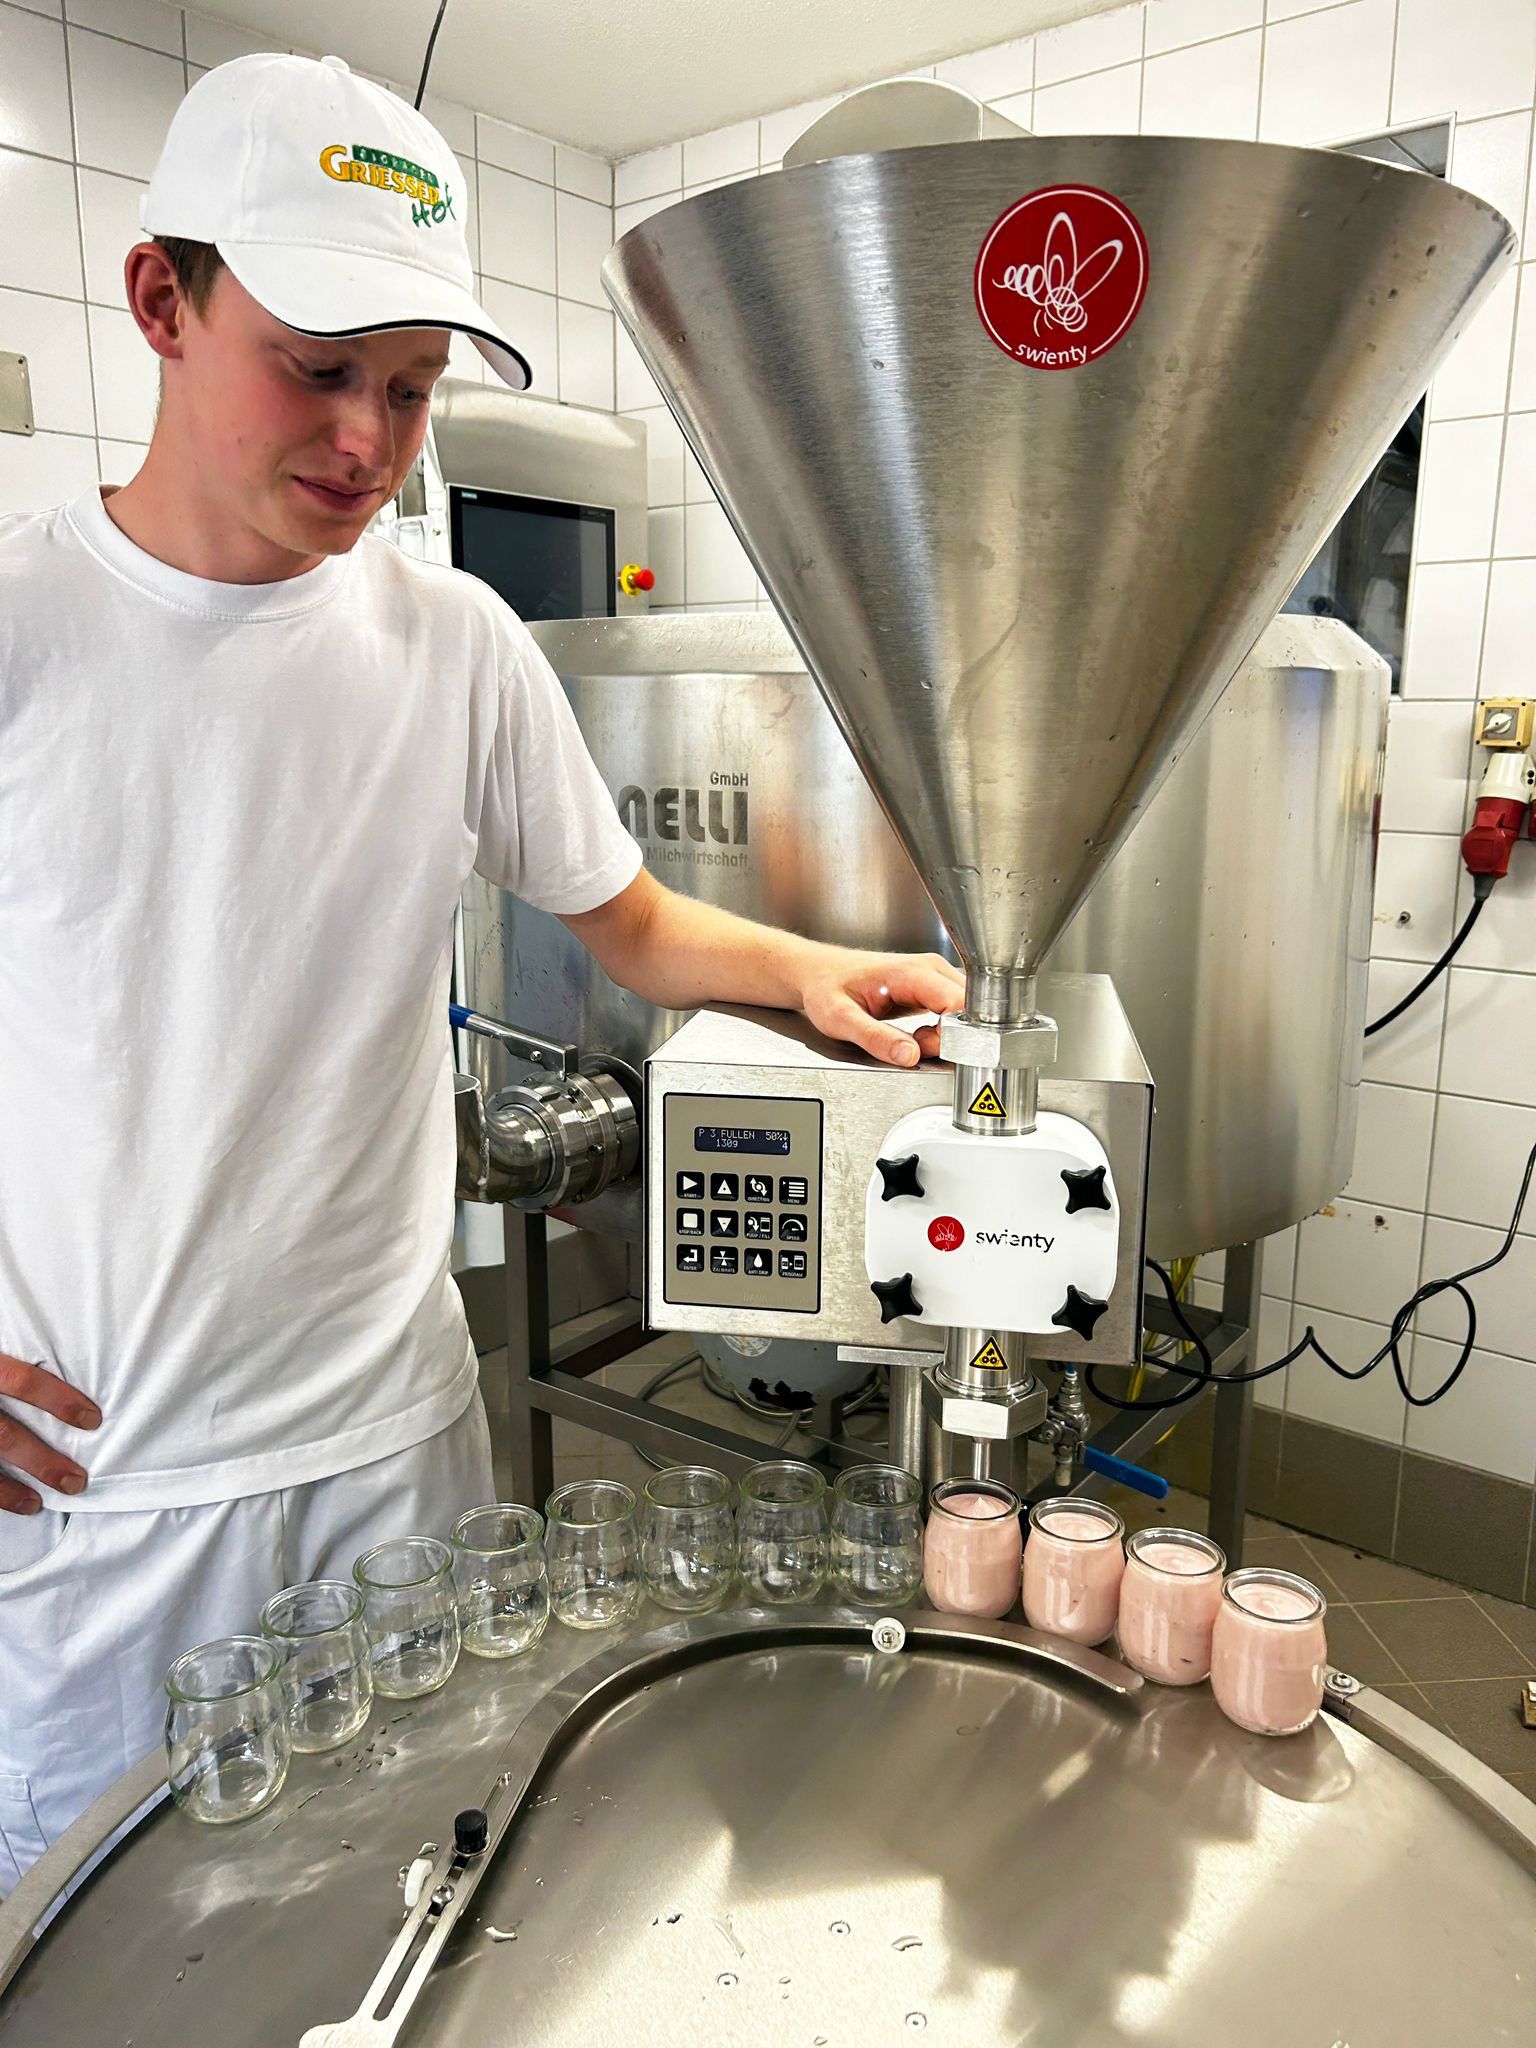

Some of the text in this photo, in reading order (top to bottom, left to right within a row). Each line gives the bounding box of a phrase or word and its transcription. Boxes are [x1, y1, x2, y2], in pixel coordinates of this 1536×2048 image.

[319, 144, 440, 206] GRIESSER
[1015, 343, 1087, 365] swienty
[710, 771, 749, 786] GmbH
[647, 847, 748, 867] Milchwirtschaft
[698, 1128, 705, 1137] P
[710, 1129, 716, 1138] 3
[720, 1129, 755, 1140] FULLEN
[782, 1142, 788, 1151] 4
